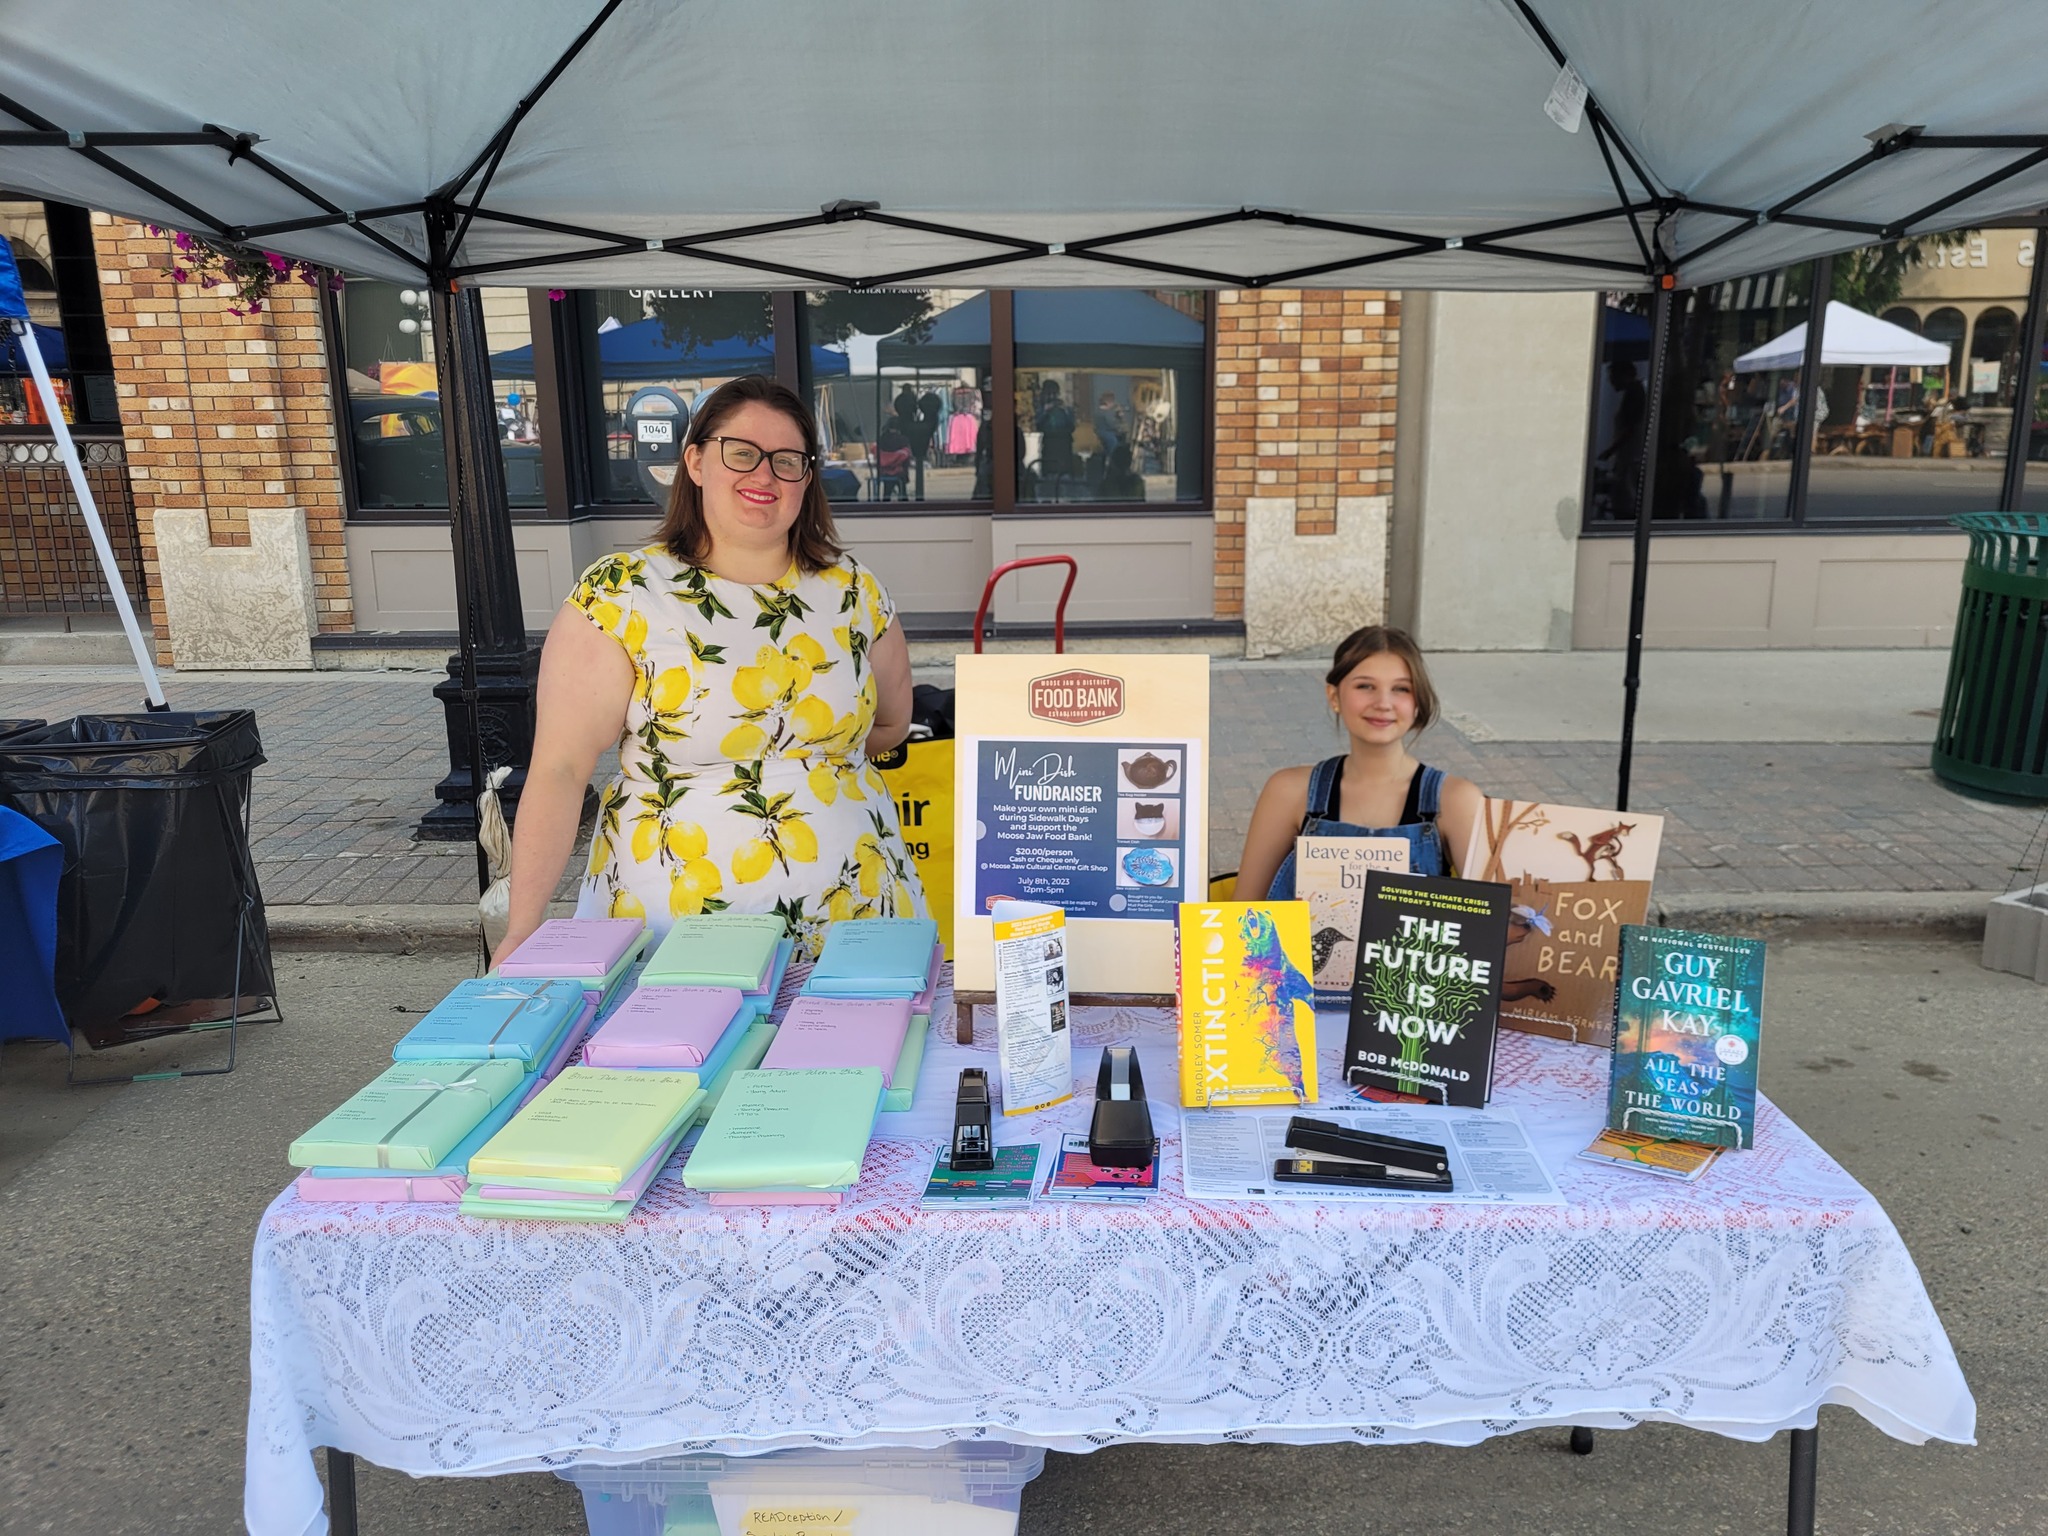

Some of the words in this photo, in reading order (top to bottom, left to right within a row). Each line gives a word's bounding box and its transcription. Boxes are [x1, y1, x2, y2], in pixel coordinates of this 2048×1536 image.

[643, 425, 667, 434] 1040
[1035, 688, 1073, 708] FOOD
[1076, 687, 1118, 709] BANK
[995, 747, 1033, 790] Mini
[1032, 753, 1077, 785] Dish
[1014, 785, 1102, 802] FUNDRAISER
[993, 804, 1016, 812] Make
[1017, 805, 1036, 814] your
[1058, 805, 1078, 813] mini
[1079, 806, 1097, 814] dish
[999, 814, 1027, 823] during
[1029, 814, 1066, 822] Sidewalk
[1068, 815, 1089, 824] Days
[997, 832, 1024, 840] Moose
[1026, 832, 1043, 840] Jaw
[1010, 823, 1026, 831] and
[1028, 824, 1060, 832] support
[1063, 824, 1077, 832] the
[1016, 847, 1073, 857] $20.00/person
[1064, 857, 1080, 865] only
[1305, 841, 1350, 860] leave
[1354, 848, 1403, 862] some
[1348, 862, 1362, 870] for
[1018, 877, 1034, 885] July
[1023, 886, 1064, 894] 12pm-5pm
[1378, 893, 1396, 902] WITH
[1399, 896, 1430, 906] TODAY'S
[1432, 901, 1492, 915] TECHNOLOGIES
[1381, 886, 1412, 896] SOLVING
[1414, 890, 1428, 898] THE
[1430, 893, 1462, 902] CLIMATE
[1464, 898, 1489, 907] CRISIS
[1555, 892, 1624, 924] FOX
[1399, 915, 1462, 946] THE
[1558, 925, 1604, 948] and
[1652, 937, 1694, 947] NATIONAL
[1697, 942, 1750, 955] BESTSELLER
[1364, 942, 1492, 984] FUTURE
[1537, 946, 1618, 982] BEAR
[1664, 952, 1723, 980] GUY
[1200, 909, 1230, 1102] EXTINCTION
[1406, 982, 1436, 1008] IS
[1632, 976, 1750, 1013] GAVRIEL
[1512, 1007, 1558, 1020] MIRIAM
[1662, 1009, 1716, 1037] KAY
[1193, 1012, 1202, 1049] SOMER
[1378, 1010, 1460, 1045] NOW
[1358, 1050, 1387, 1066] BOB
[1391, 1057, 1470, 1082] McDONALD
[1644, 1058, 1680, 1075] ALL
[1688, 1063, 1726, 1082] THE
[1195, 1054, 1204, 1102] BRADLEY
[1656, 1076, 1699, 1096] SEAS
[1702, 1088, 1715, 1096] of
[1625, 1090, 1662, 1109] THE
[1670, 1097, 1742, 1120] WORLD
[754, 1512, 830, 1523] READception
